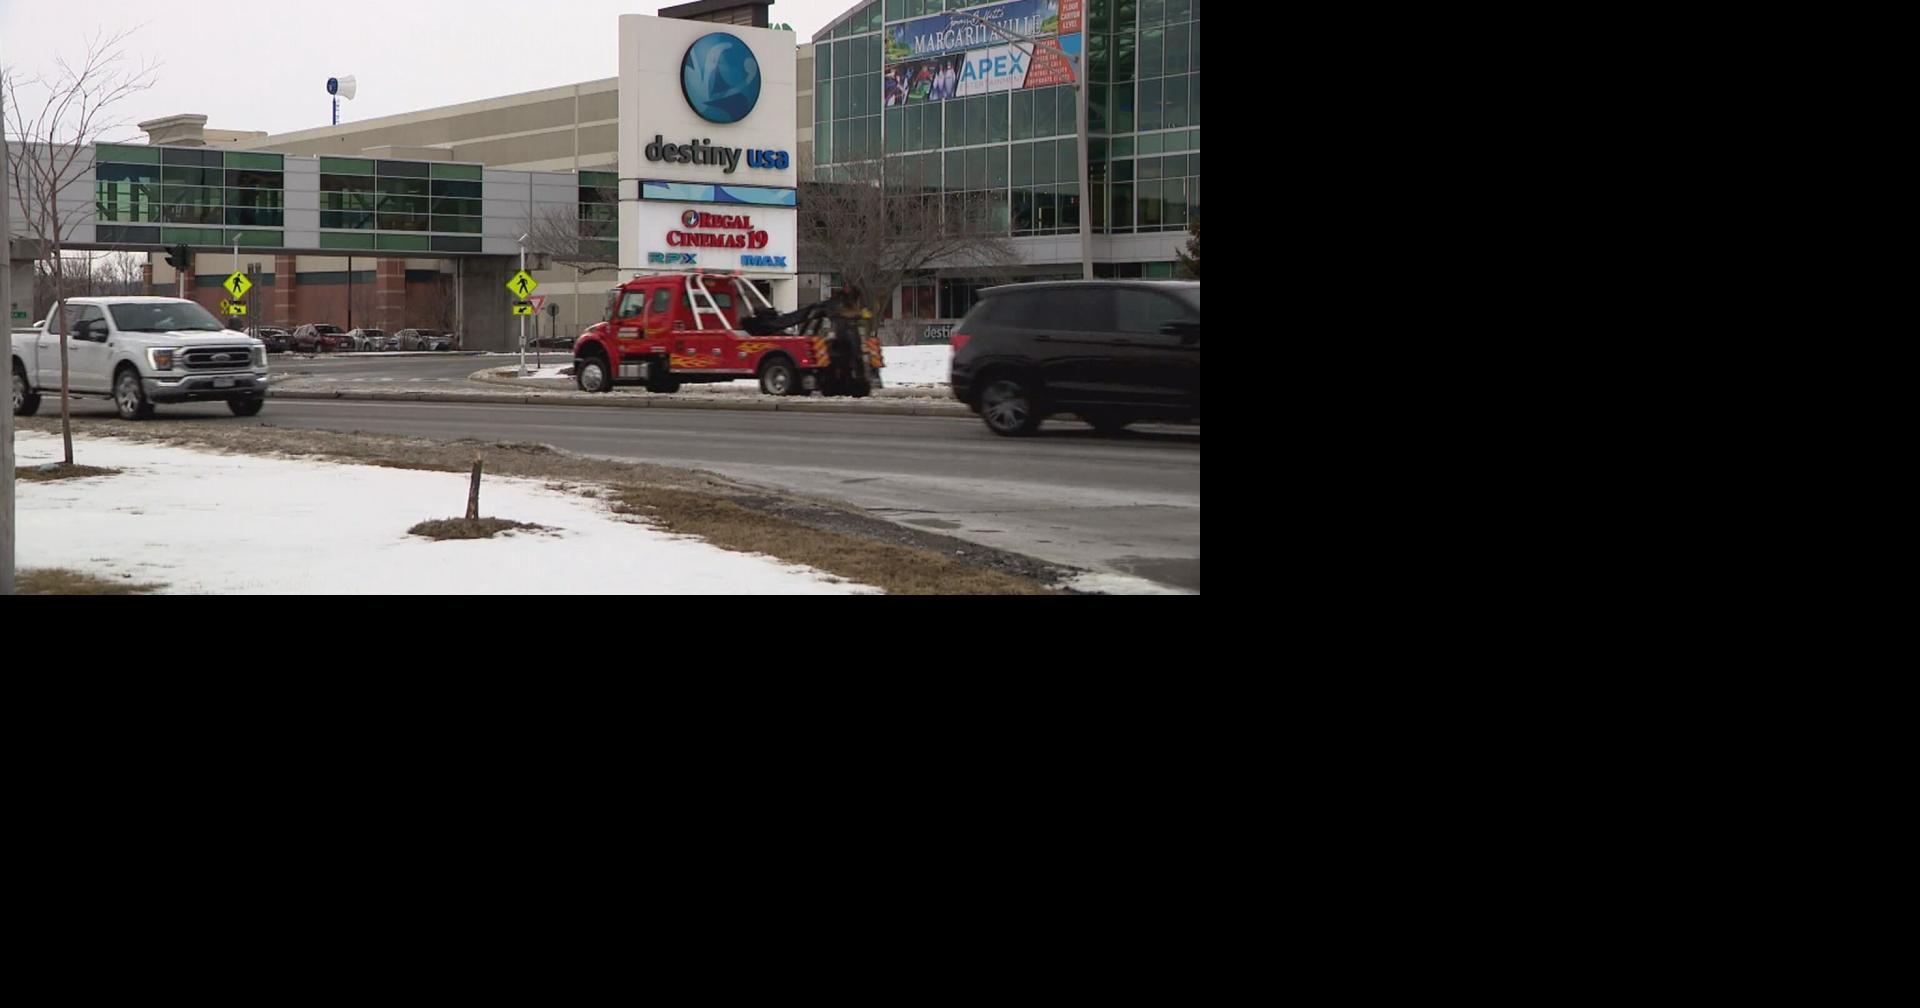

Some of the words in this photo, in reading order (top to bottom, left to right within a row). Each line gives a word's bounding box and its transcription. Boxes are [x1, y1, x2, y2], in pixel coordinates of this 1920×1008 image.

[914, 14, 1041, 54] MARGARITAVILLE
[961, 51, 1024, 82] APEX
[645, 134, 742, 174] destiny
[746, 149, 790, 170] usa
[698, 211, 755, 229] REGAL
[666, 231, 746, 249] CINEMAS
[747, 230, 769, 249] 19
[647, 252, 697, 264] RPX
[740, 254, 787, 267] IMAX
